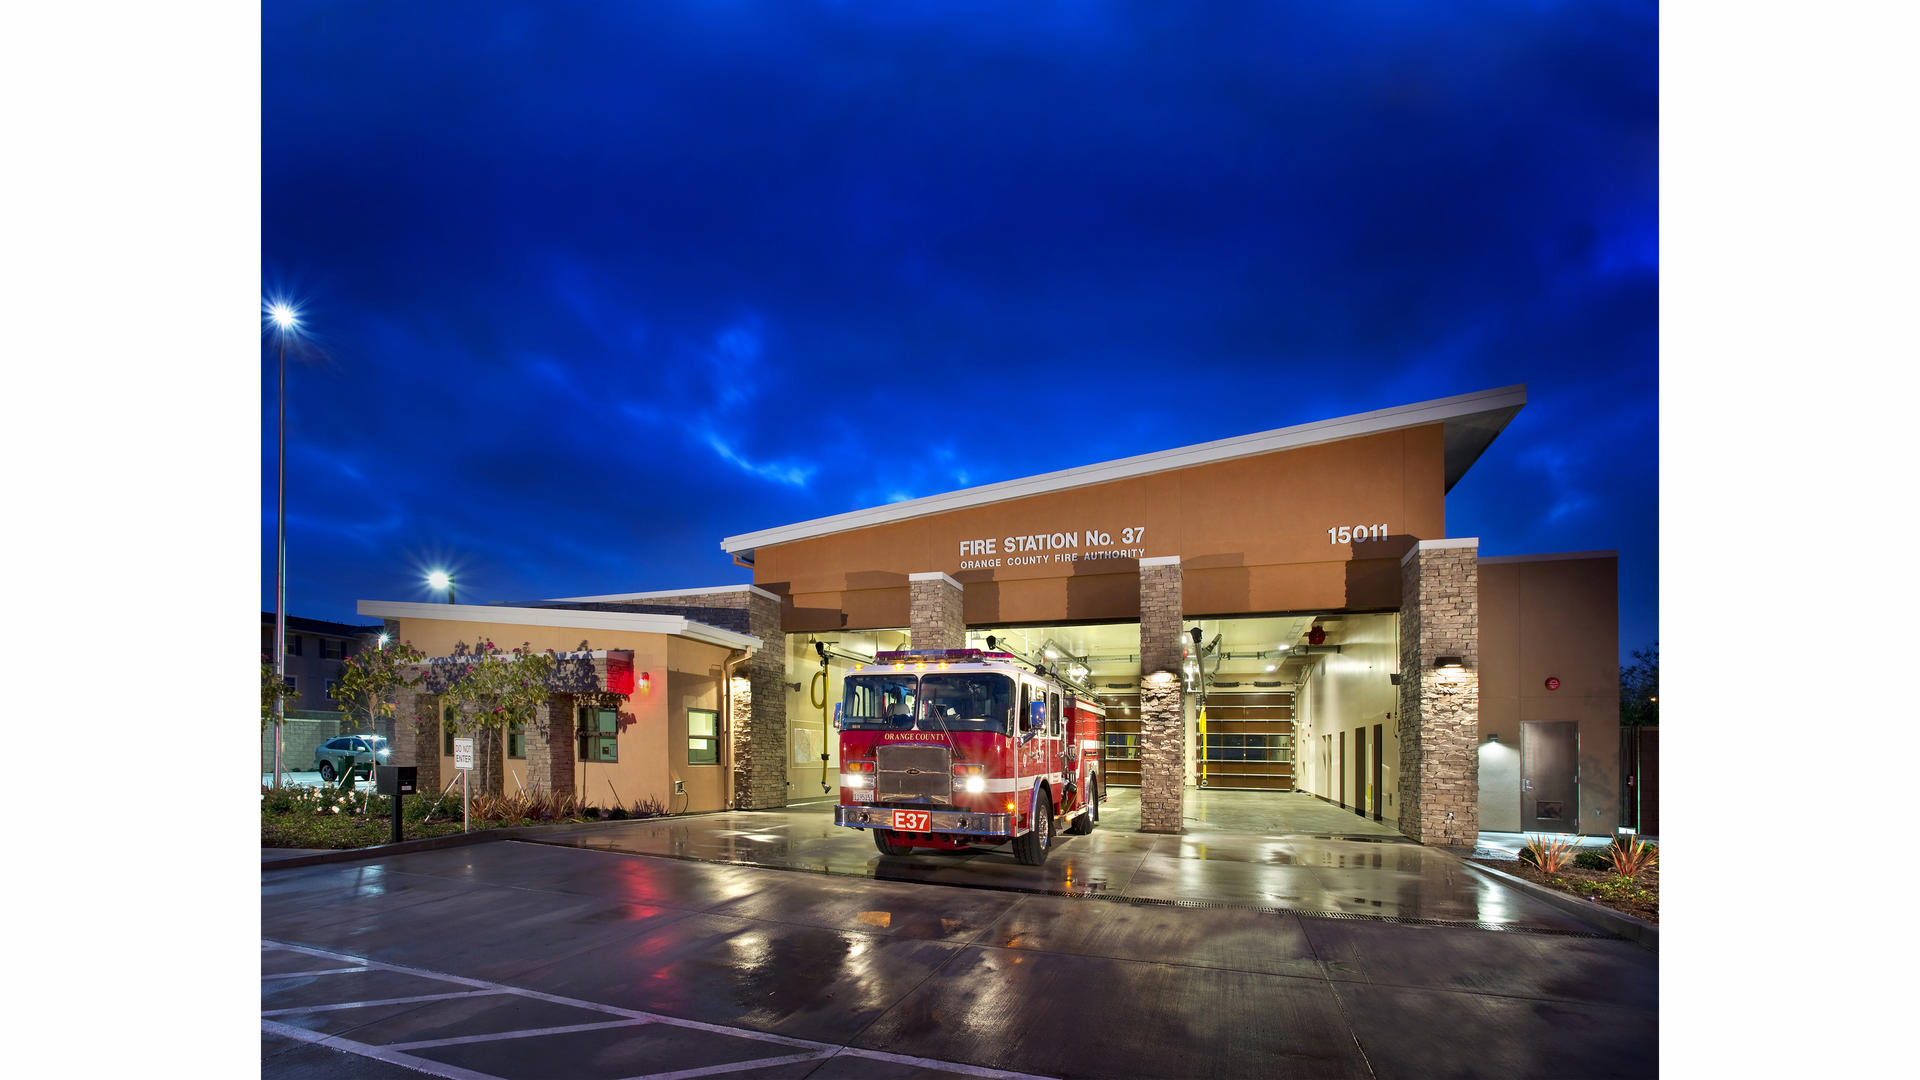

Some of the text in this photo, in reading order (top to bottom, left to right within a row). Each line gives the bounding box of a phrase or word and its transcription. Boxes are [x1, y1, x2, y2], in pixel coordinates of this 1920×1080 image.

[960, 526, 1145, 557] FIRE STATION No. 37
[1327, 523, 1388, 545] 15011
[960, 548, 1145, 569] ORANGE COUNTY FIRE AUTHORITY
[884, 733, 945, 741] ORANGE COUNTY
[455, 744, 472, 753] DO NOT
[456, 754, 472, 763] ENTER
[895, 812, 928, 829] E37
